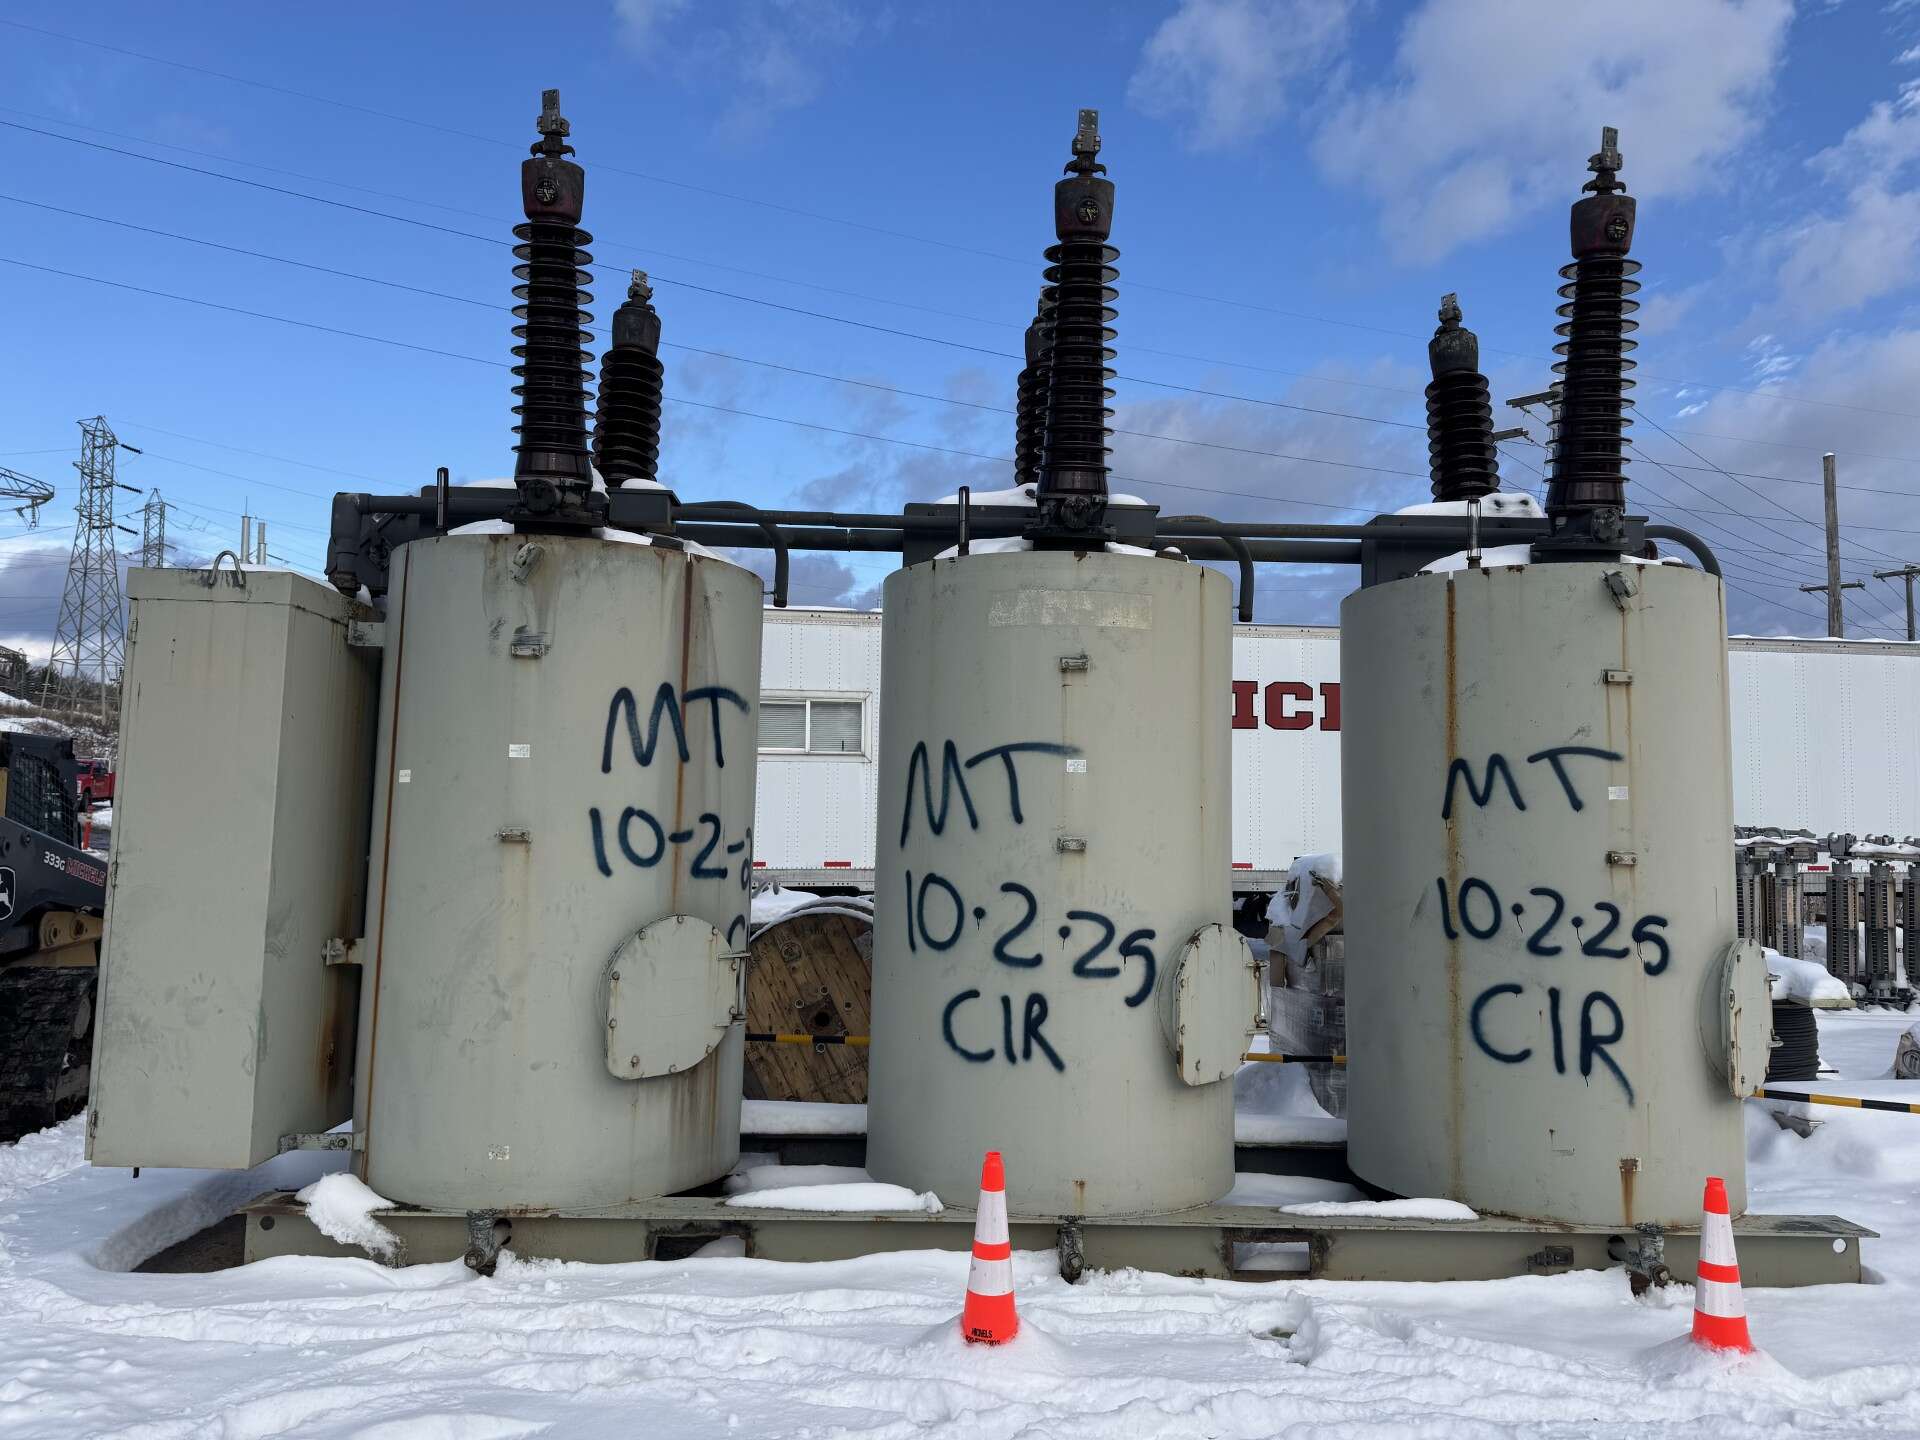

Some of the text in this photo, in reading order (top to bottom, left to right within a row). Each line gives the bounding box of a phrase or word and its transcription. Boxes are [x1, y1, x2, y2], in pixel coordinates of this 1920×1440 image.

[601, 682, 751, 774] MT
[901, 739, 1082, 849] MT
[1441, 746, 1624, 821] MT
[43, 851, 66, 871] 333G
[942, 993, 1065, 1072] CIR
[1470, 983, 1636, 1109] CIR
